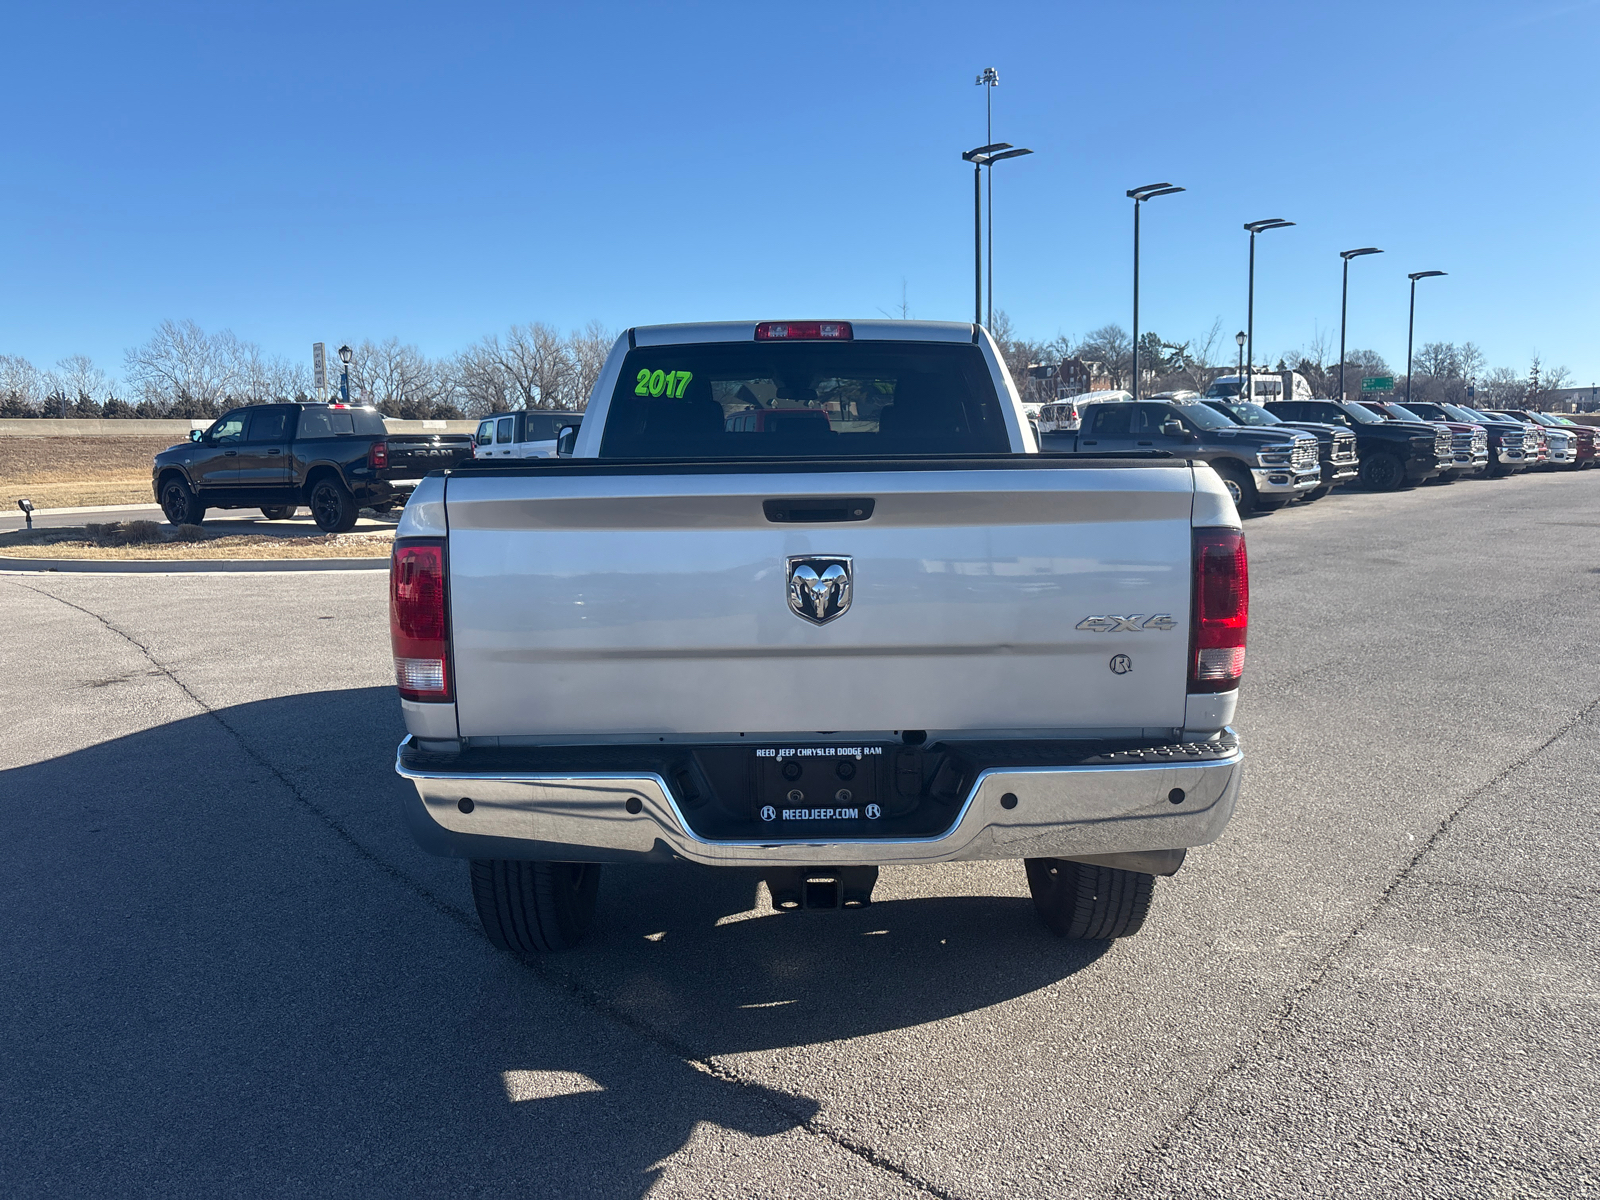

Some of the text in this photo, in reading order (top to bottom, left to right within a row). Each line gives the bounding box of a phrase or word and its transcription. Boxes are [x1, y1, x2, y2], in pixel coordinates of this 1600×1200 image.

[634, 368, 693, 398] 2017
[414, 450, 454, 458] RAM
[1075, 613, 1178, 632] 4X4
[756, 747, 882, 757] REED JEEP CHRYSLER DODGE RAM
[782, 808, 858, 820] REEDJEEP.COM
